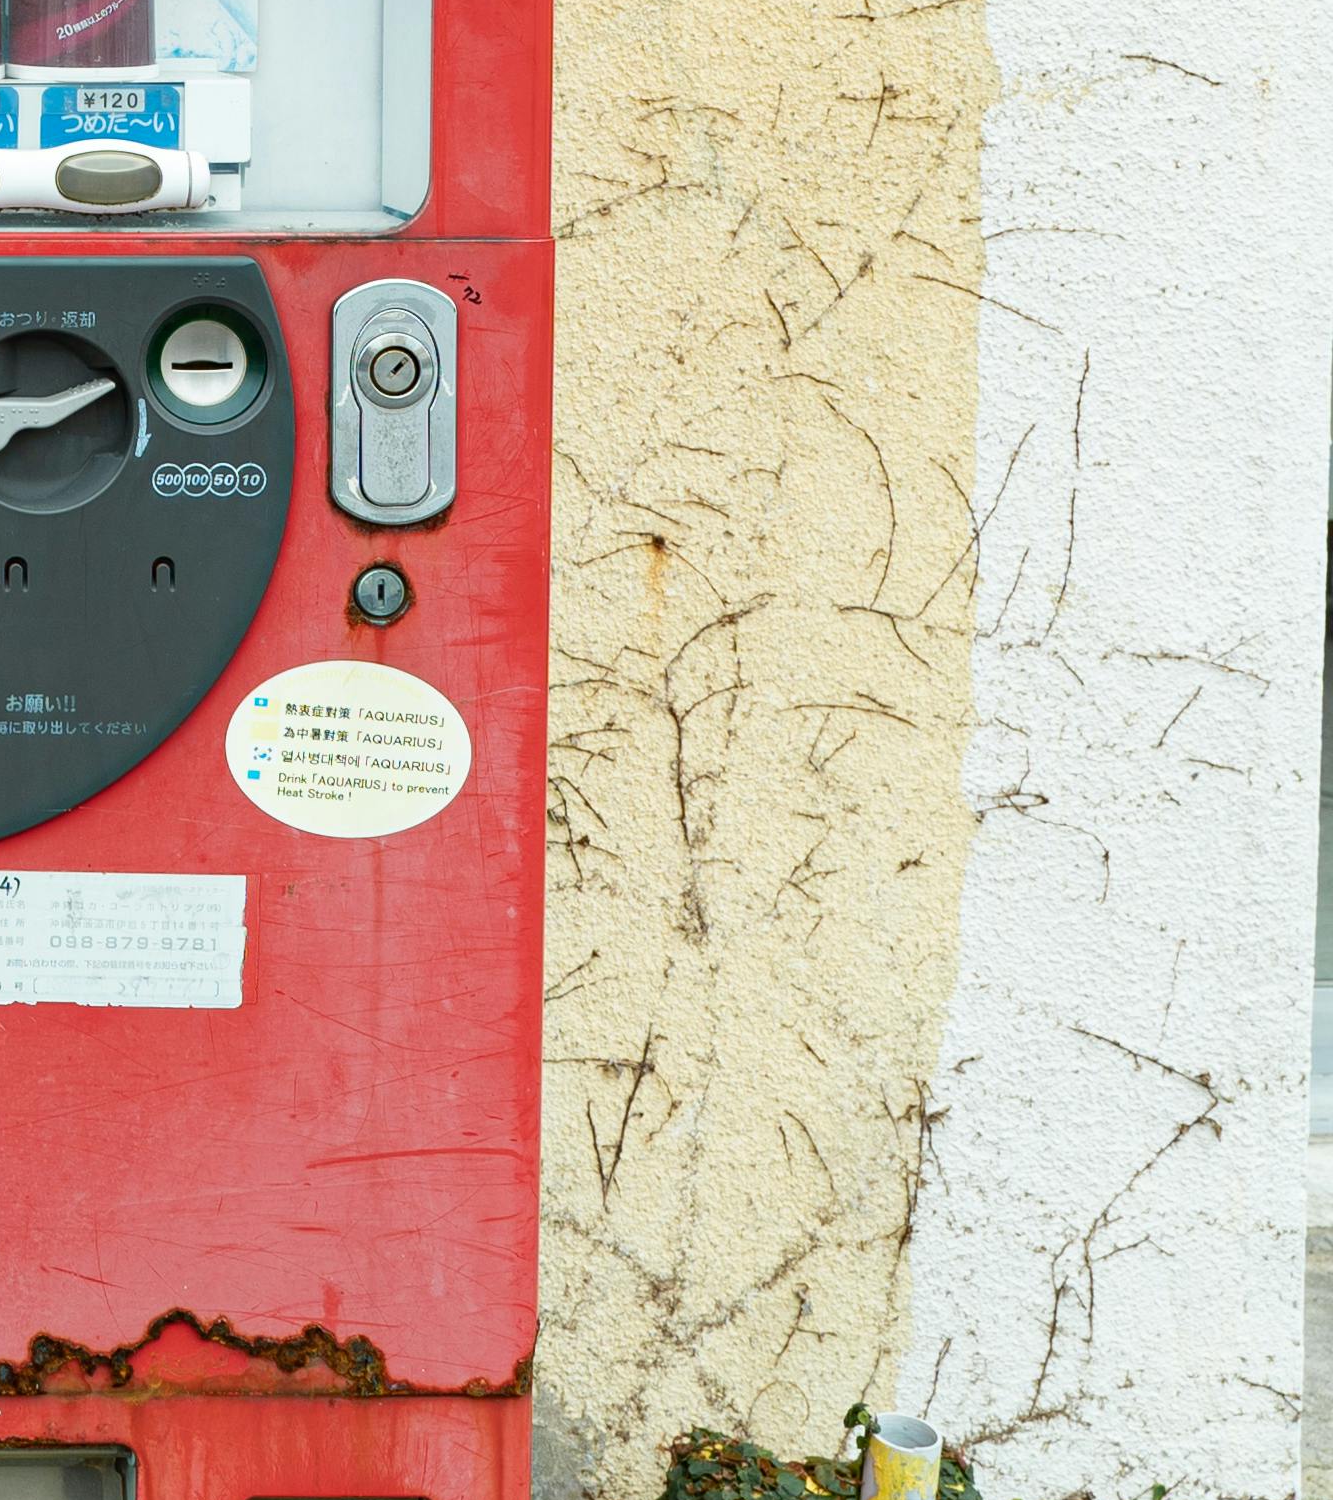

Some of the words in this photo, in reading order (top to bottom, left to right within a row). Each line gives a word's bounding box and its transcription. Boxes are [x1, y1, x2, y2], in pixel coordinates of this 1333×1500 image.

[84, 92, 138, 109] ¥120
[0, 311, 96, 328] おつり・返却
[156, 474, 182, 485] 500
[185, 474, 208, 485] 100
[213, 474, 233, 485] 50
[242, 474, 260, 485] 10
[279, 773, 307, 784] Drink
[392, 782, 403, 791] to
[407, 784, 449, 795] prevent
[277, 787, 303, 798] Heat
[50, 935, 218, 951] 098-879-9781
